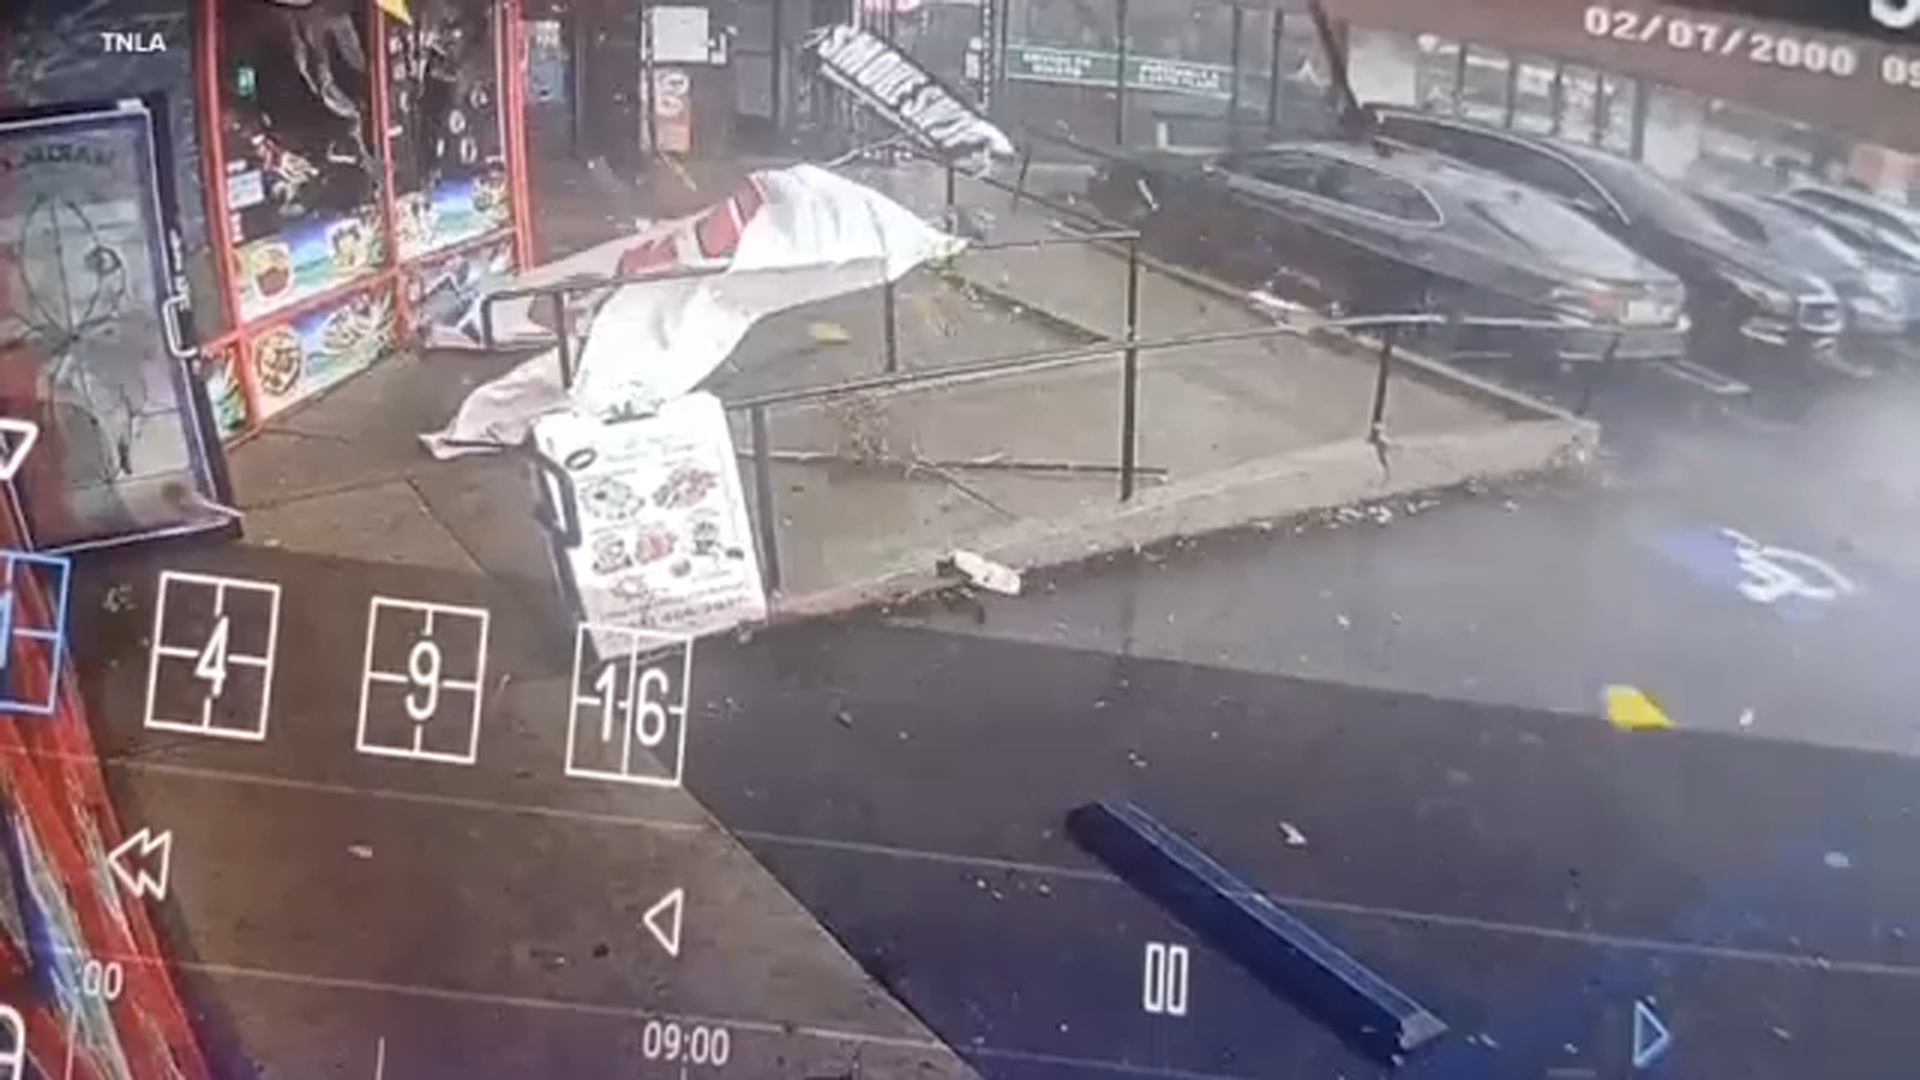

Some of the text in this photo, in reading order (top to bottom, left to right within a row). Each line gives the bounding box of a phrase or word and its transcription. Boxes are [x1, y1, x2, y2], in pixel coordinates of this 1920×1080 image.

[817, 24, 929, 105] SMOKE
[195, 615, 229, 697] 4
[405, 640, 441, 720] 9
[596, 664, 669, 746] 16
[643, 1020, 730, 1066] 09:00
